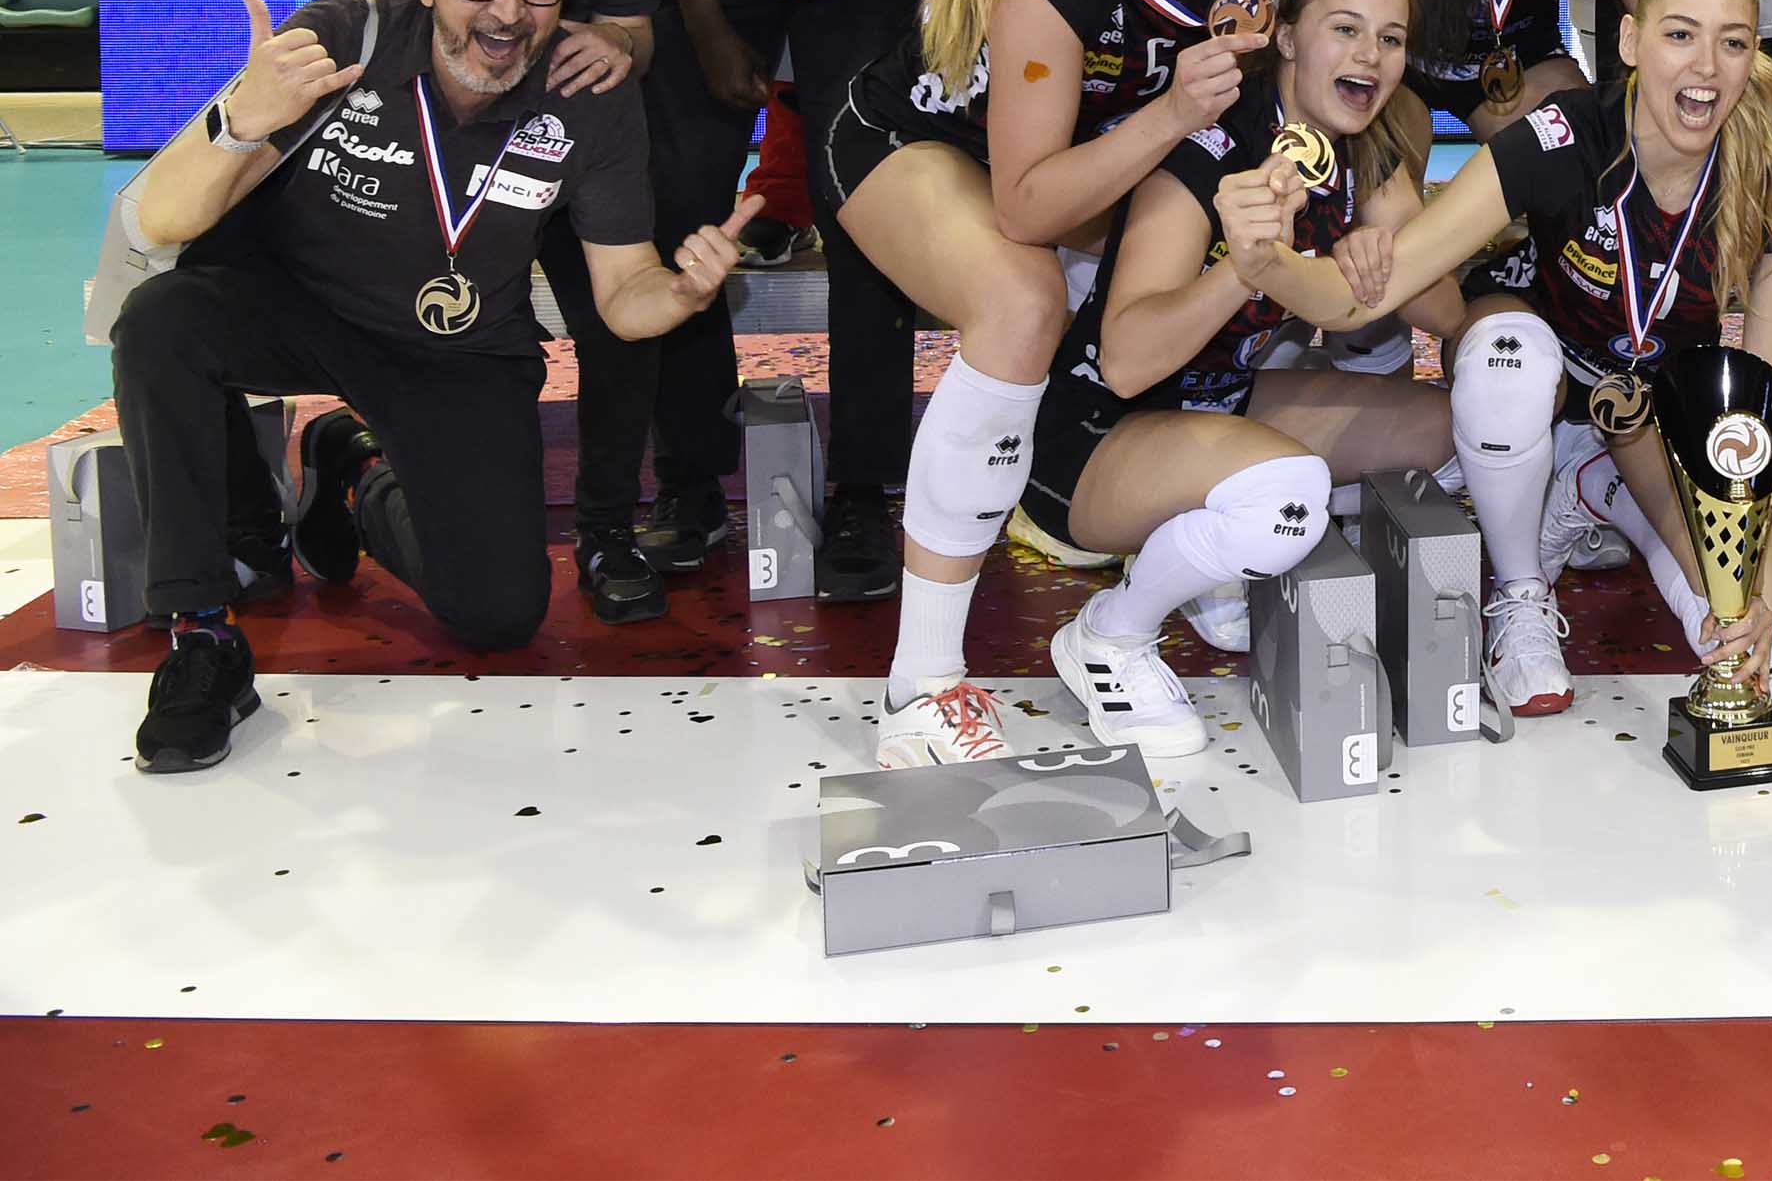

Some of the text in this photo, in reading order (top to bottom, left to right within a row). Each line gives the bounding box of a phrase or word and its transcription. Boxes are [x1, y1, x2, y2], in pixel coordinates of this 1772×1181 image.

[1138, 37, 1176, 96] 5
[341, 108, 379, 127] errea
[322, 121, 415, 166] Ricola
[513, 131, 571, 151] ASPTT
[307, 147, 380, 196] Kara
[340, 200, 387, 220] patrimoine
[1488, 357, 1522, 370] errea
[988, 452, 1020, 467] errea
[1273, 522, 1307, 538] errea
[1721, 730, 1769, 744] VAINQUEUR
